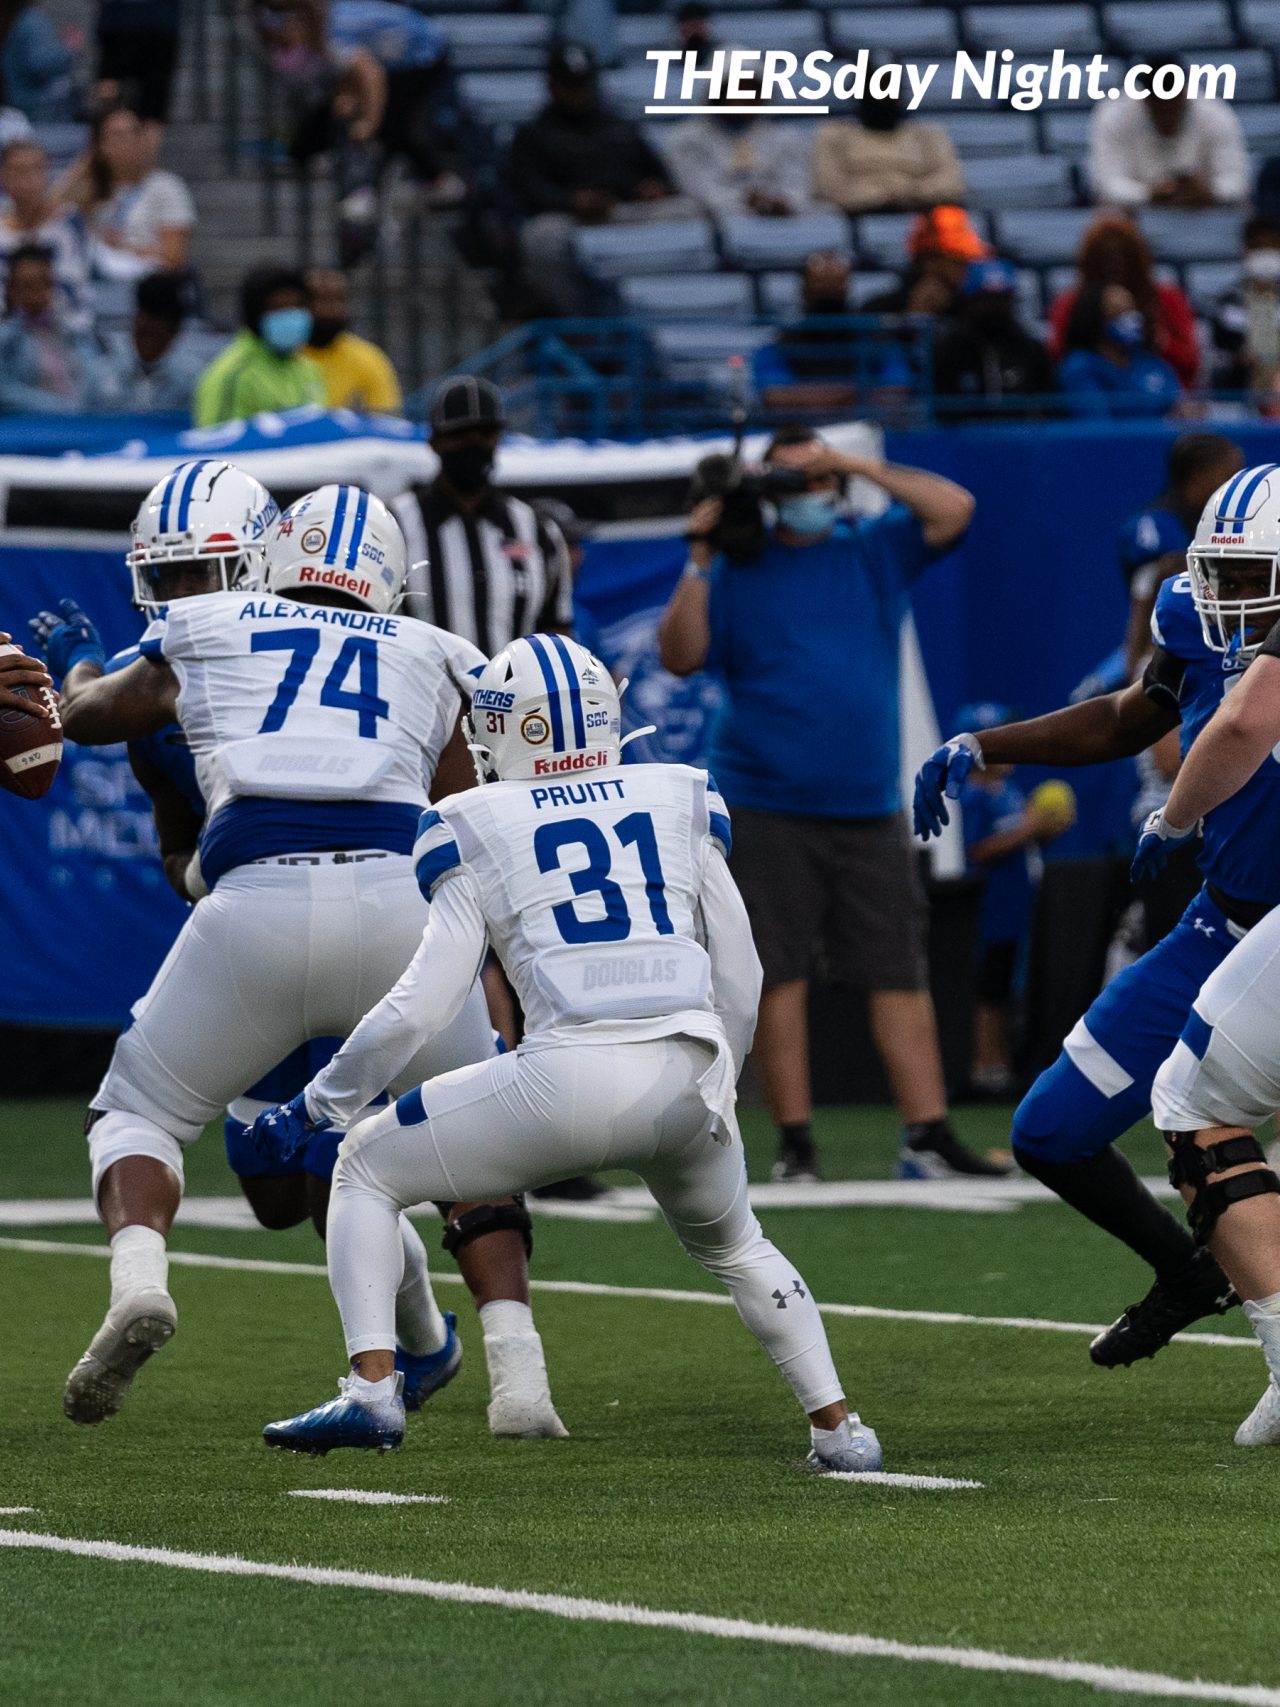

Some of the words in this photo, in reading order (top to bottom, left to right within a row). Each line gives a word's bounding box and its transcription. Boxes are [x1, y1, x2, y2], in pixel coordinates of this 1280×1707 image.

[361, 543, 385, 565] SBC
[1211, 535, 1245, 545] Riddell
[300, 566, 371, 598] Riddell
[239, 601, 401, 637] ALEXANDRE
[251, 627, 389, 739] 74
[486, 711, 505, 734] 31
[586, 711, 608, 728] SBC
[534, 751, 608, 775] Riddell
[531, 779, 625, 809] PRUITT
[534, 812, 675, 944] 31
[581, 957, 679, 990] DOUGLAS
